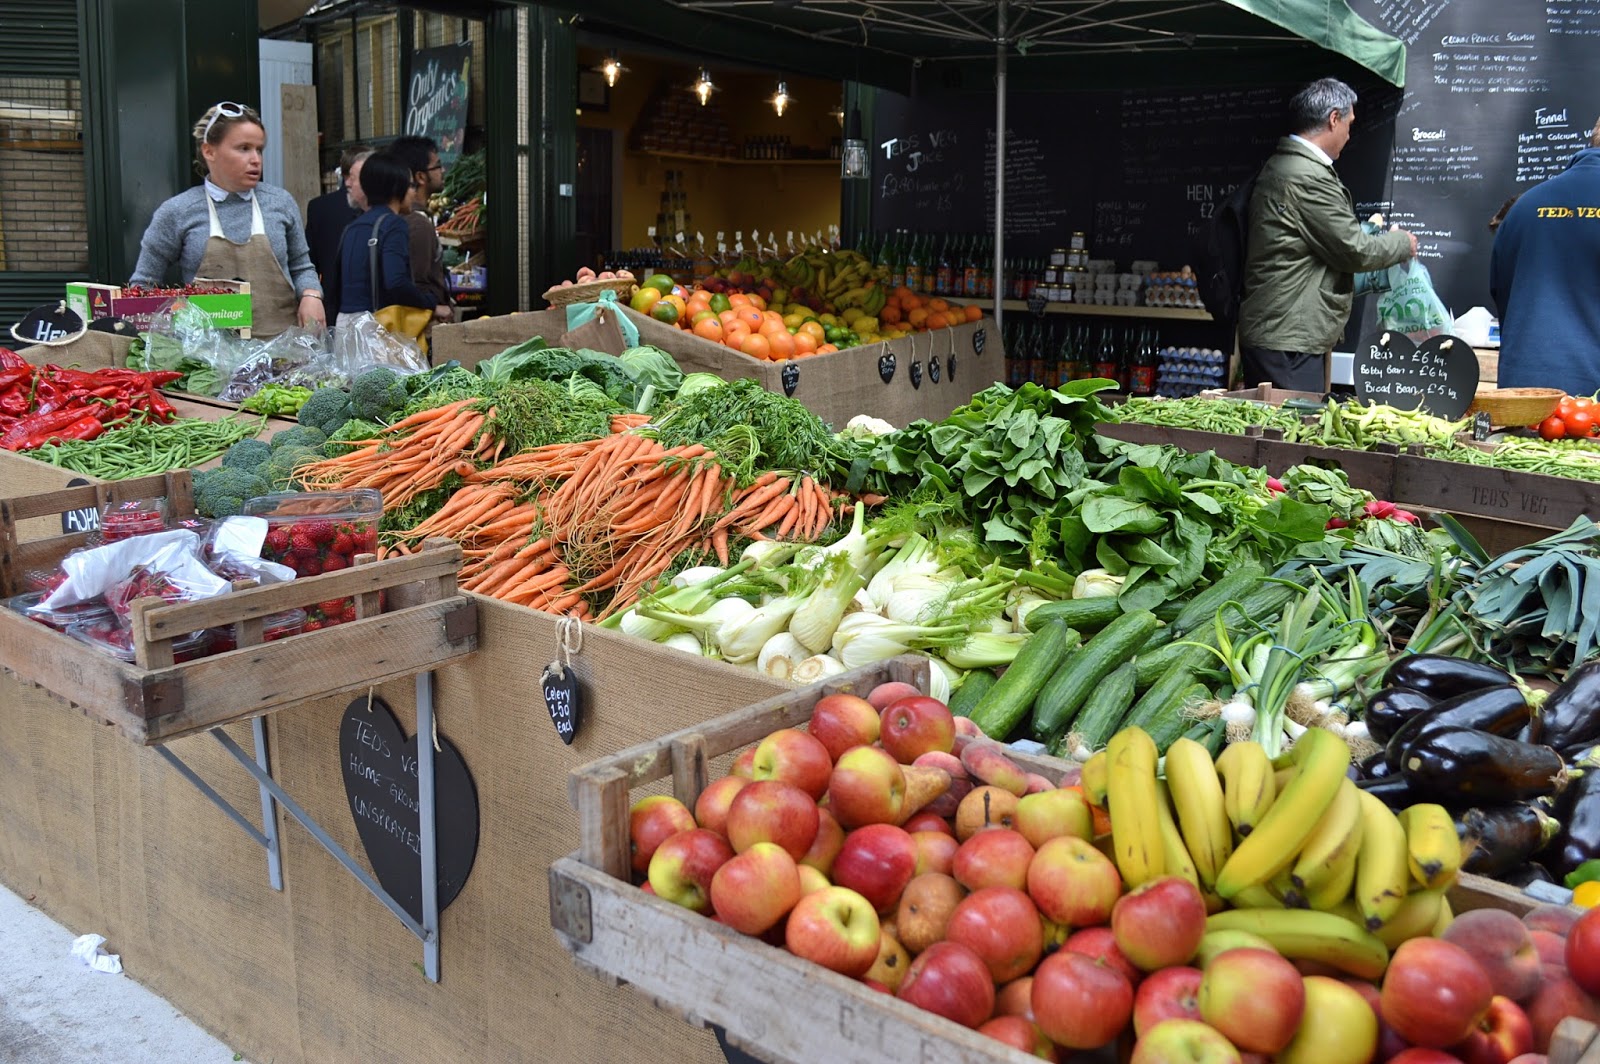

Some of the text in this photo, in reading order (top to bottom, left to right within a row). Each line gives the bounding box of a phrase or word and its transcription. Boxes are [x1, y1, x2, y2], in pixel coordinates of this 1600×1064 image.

[1472, 33, 1500, 44] PRINCE
[1506, 32, 1535, 42] SQUASH
[411, 60, 439, 106] Only
[407, 71, 457, 136] Organics
[1535, 108, 1567, 125] Fennel
[1412, 128, 1446, 140] Broccoli
[881, 134, 920, 159] TEDS
[906, 151, 944, 172] JUICE
[1187, 185, 1213, 201] HEN
[1200, 203, 1214, 218] £2
[1412, 350, 1429, 363] £6
[1361, 364, 1382, 378] Bobby
[1420, 366, 1436, 377] £6
[1365, 381, 1391, 393] Broad
[1427, 383, 1446, 395] £5
[1472, 487, 1548, 514] TED'S VEG
[545, 686, 570, 703] Celery
[551, 702, 569, 717] 150
[352, 718, 419, 778] TEDS VE
[350, 753, 419, 812] HOME GROW
